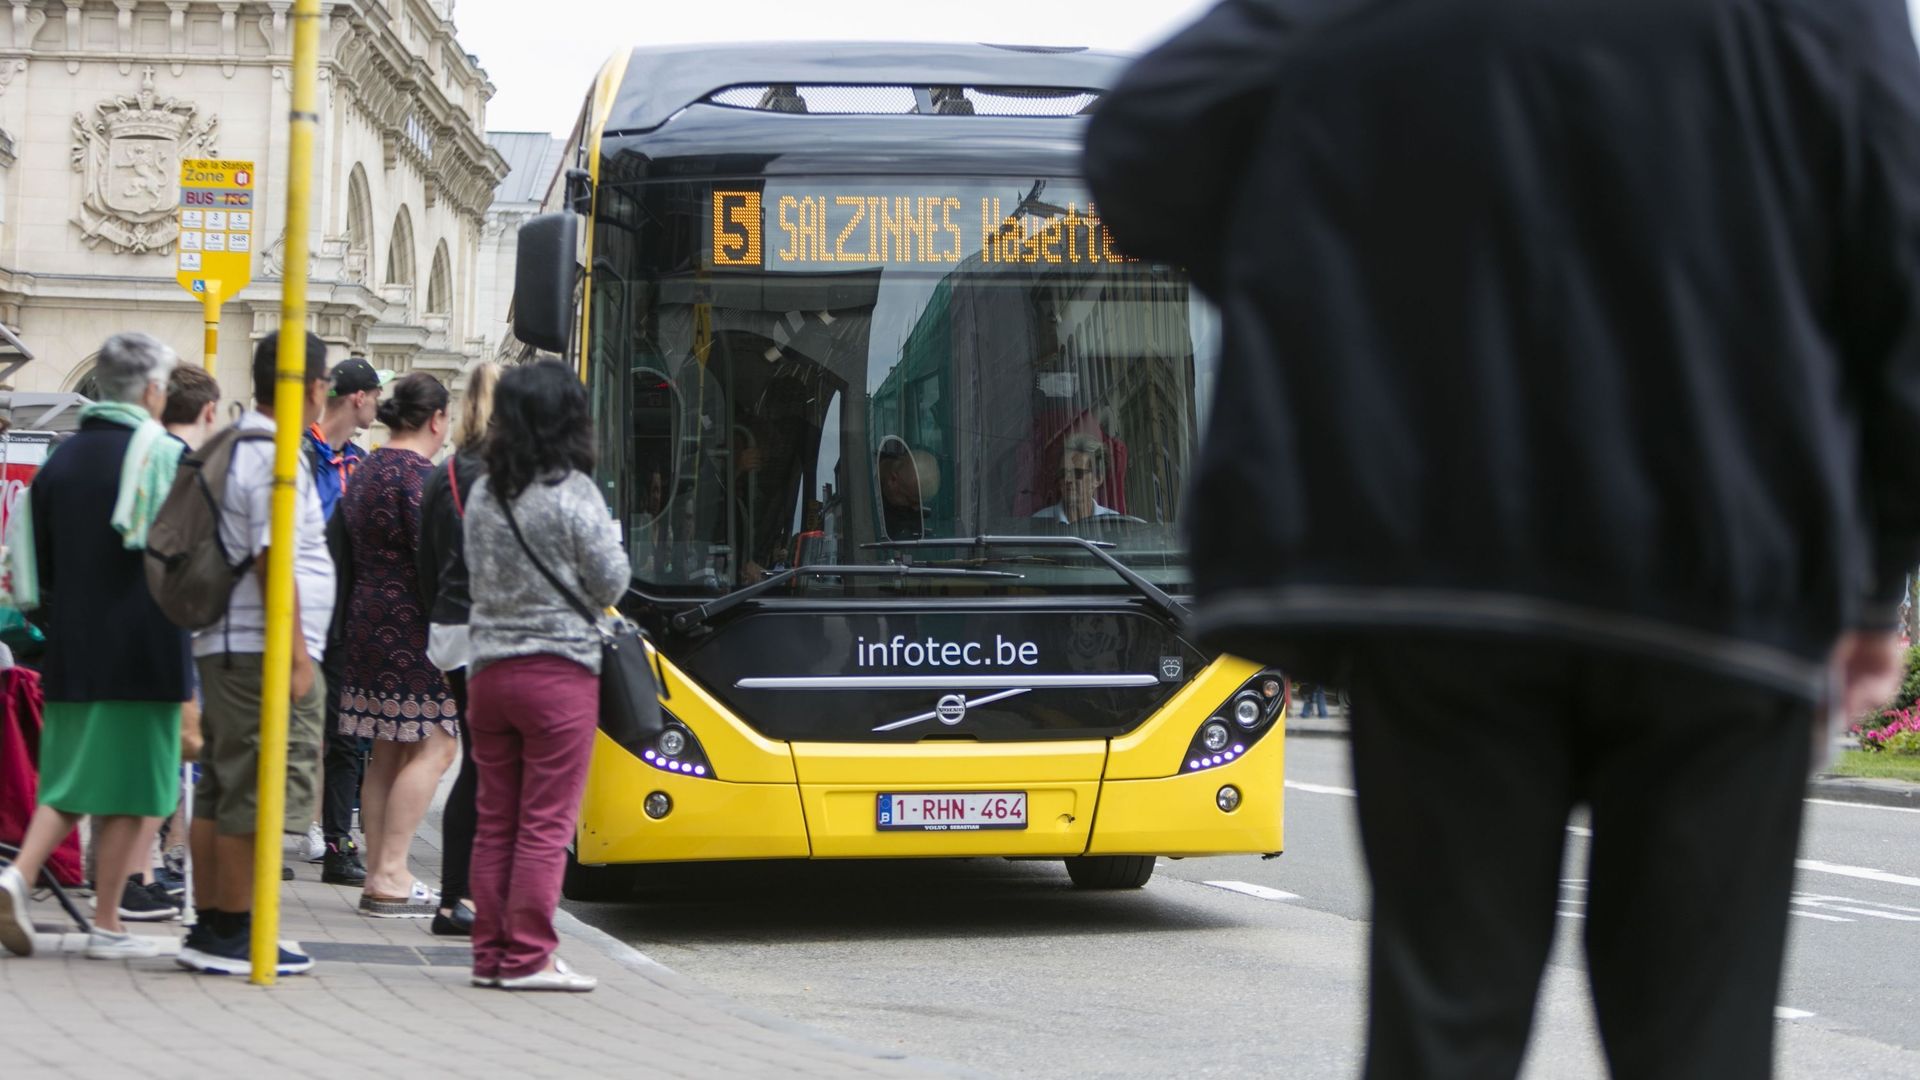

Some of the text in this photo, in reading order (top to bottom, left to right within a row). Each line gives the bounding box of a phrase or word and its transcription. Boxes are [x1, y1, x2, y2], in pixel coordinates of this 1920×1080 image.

[197, 160, 208, 168] de
[211, 161, 218, 169] la
[221, 161, 254, 170] Station
[186, 169, 225, 182] Zone
[186, 191, 250, 205] BUS TEC
[718, 194, 755, 263] 5
[778, 195, 961, 263] SALZINNES
[858, 634, 1039, 667] infotec.be
[881, 812, 890, 822] B
[896, 798, 1022, 820] 1-RHN-464
